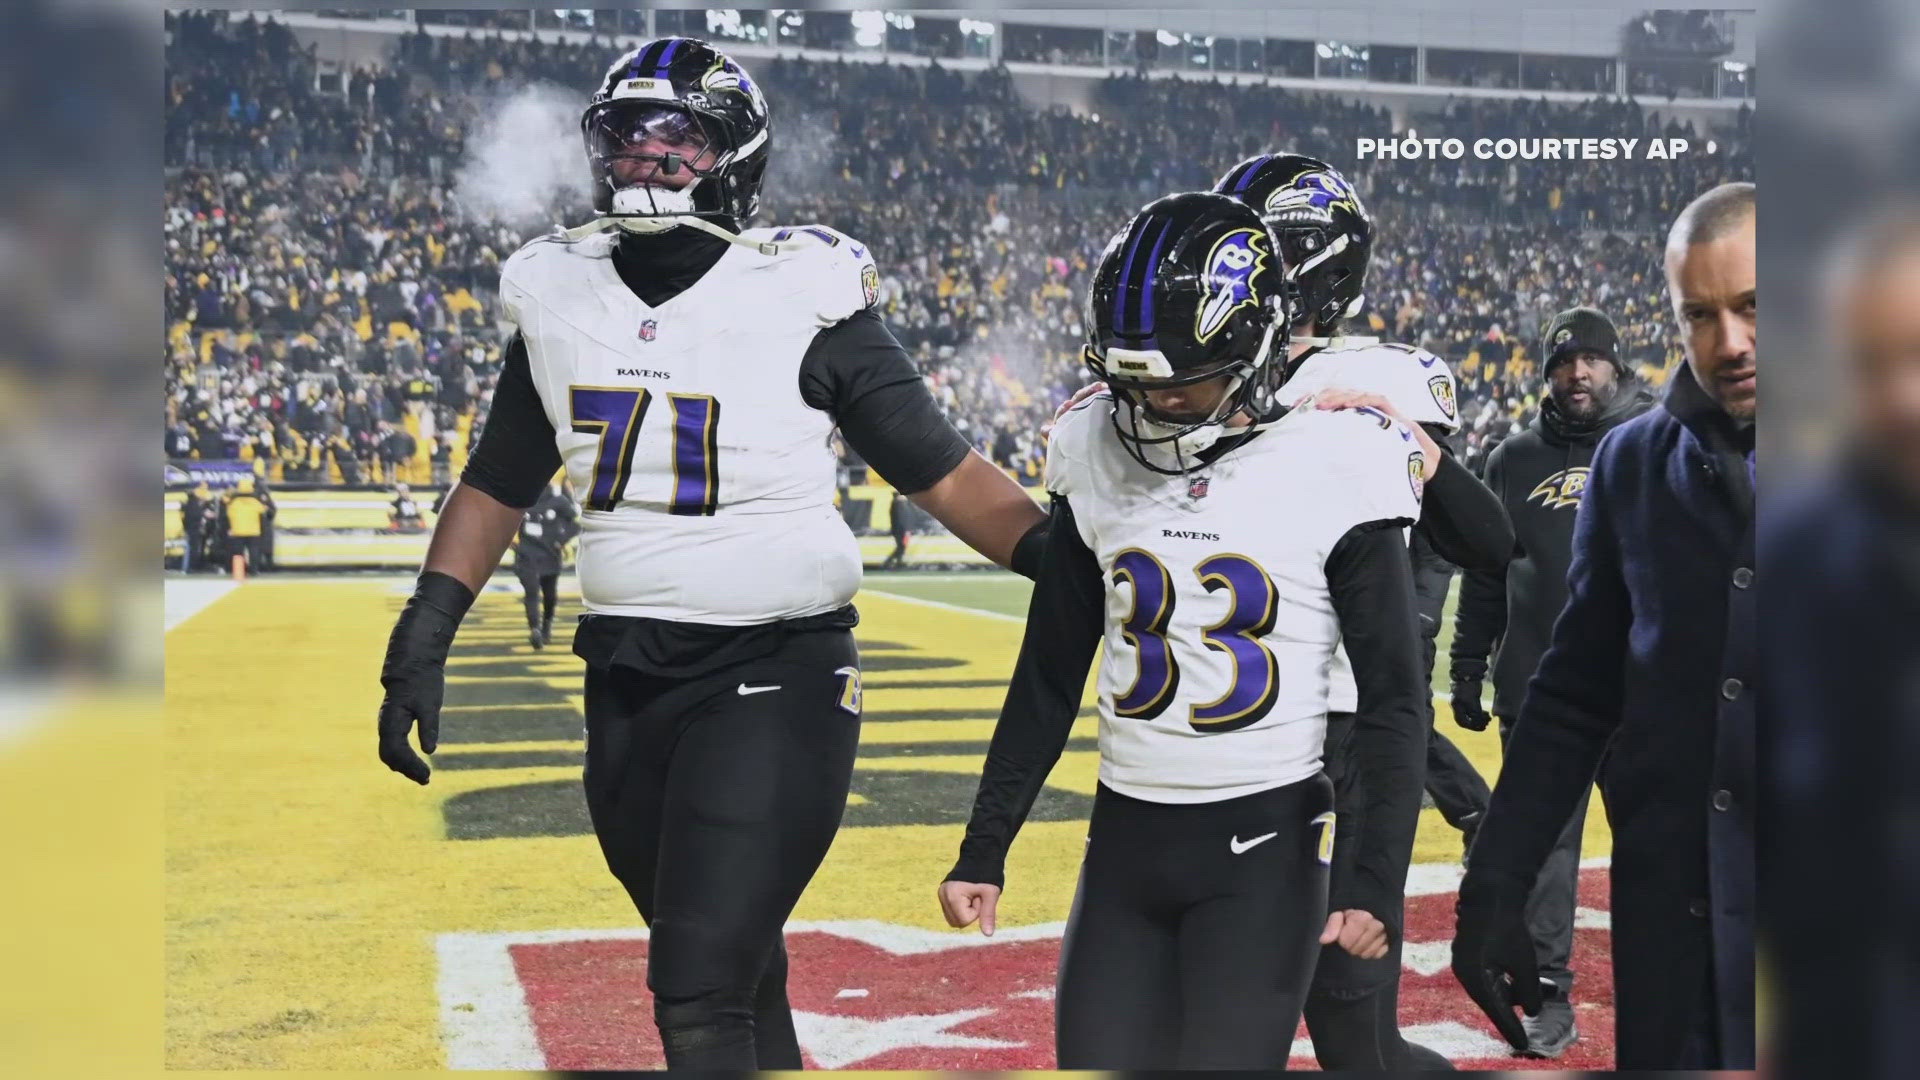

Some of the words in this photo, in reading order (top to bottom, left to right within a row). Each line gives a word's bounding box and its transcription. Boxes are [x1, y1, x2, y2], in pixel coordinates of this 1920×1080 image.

[627, 81, 655, 89] RAVENS
[616, 368, 671, 380] RAVENS
[569, 385, 721, 516] 71
[1161, 529, 1220, 541] RAVENS
[1112, 547, 1280, 732] 33
